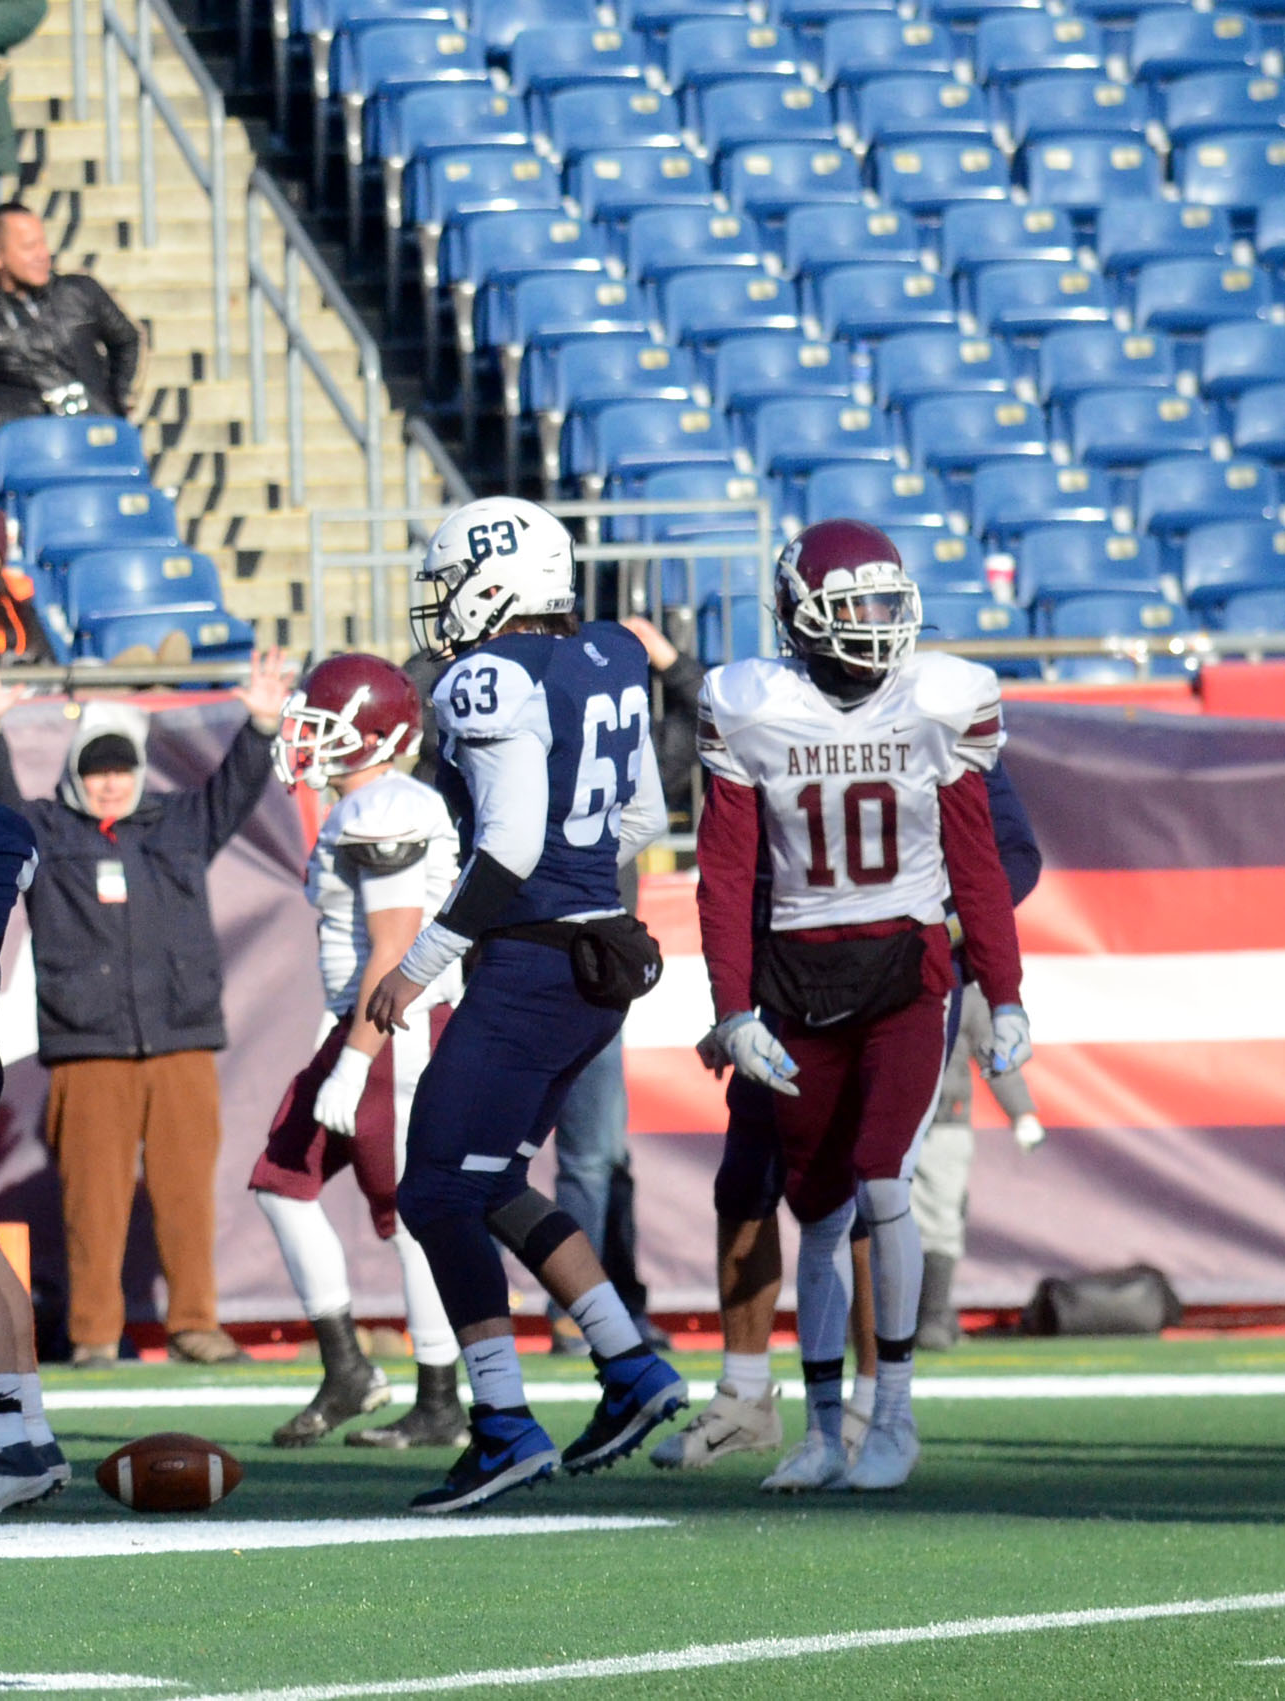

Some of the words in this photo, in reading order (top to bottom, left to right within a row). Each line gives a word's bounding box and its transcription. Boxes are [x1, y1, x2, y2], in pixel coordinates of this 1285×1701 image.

[467, 520, 517, 561] 63
[450, 668, 499, 718] 63
[563, 685, 650, 847] 63
[787, 743, 910, 776] AMHERST
[796, 781, 899, 887] 10
